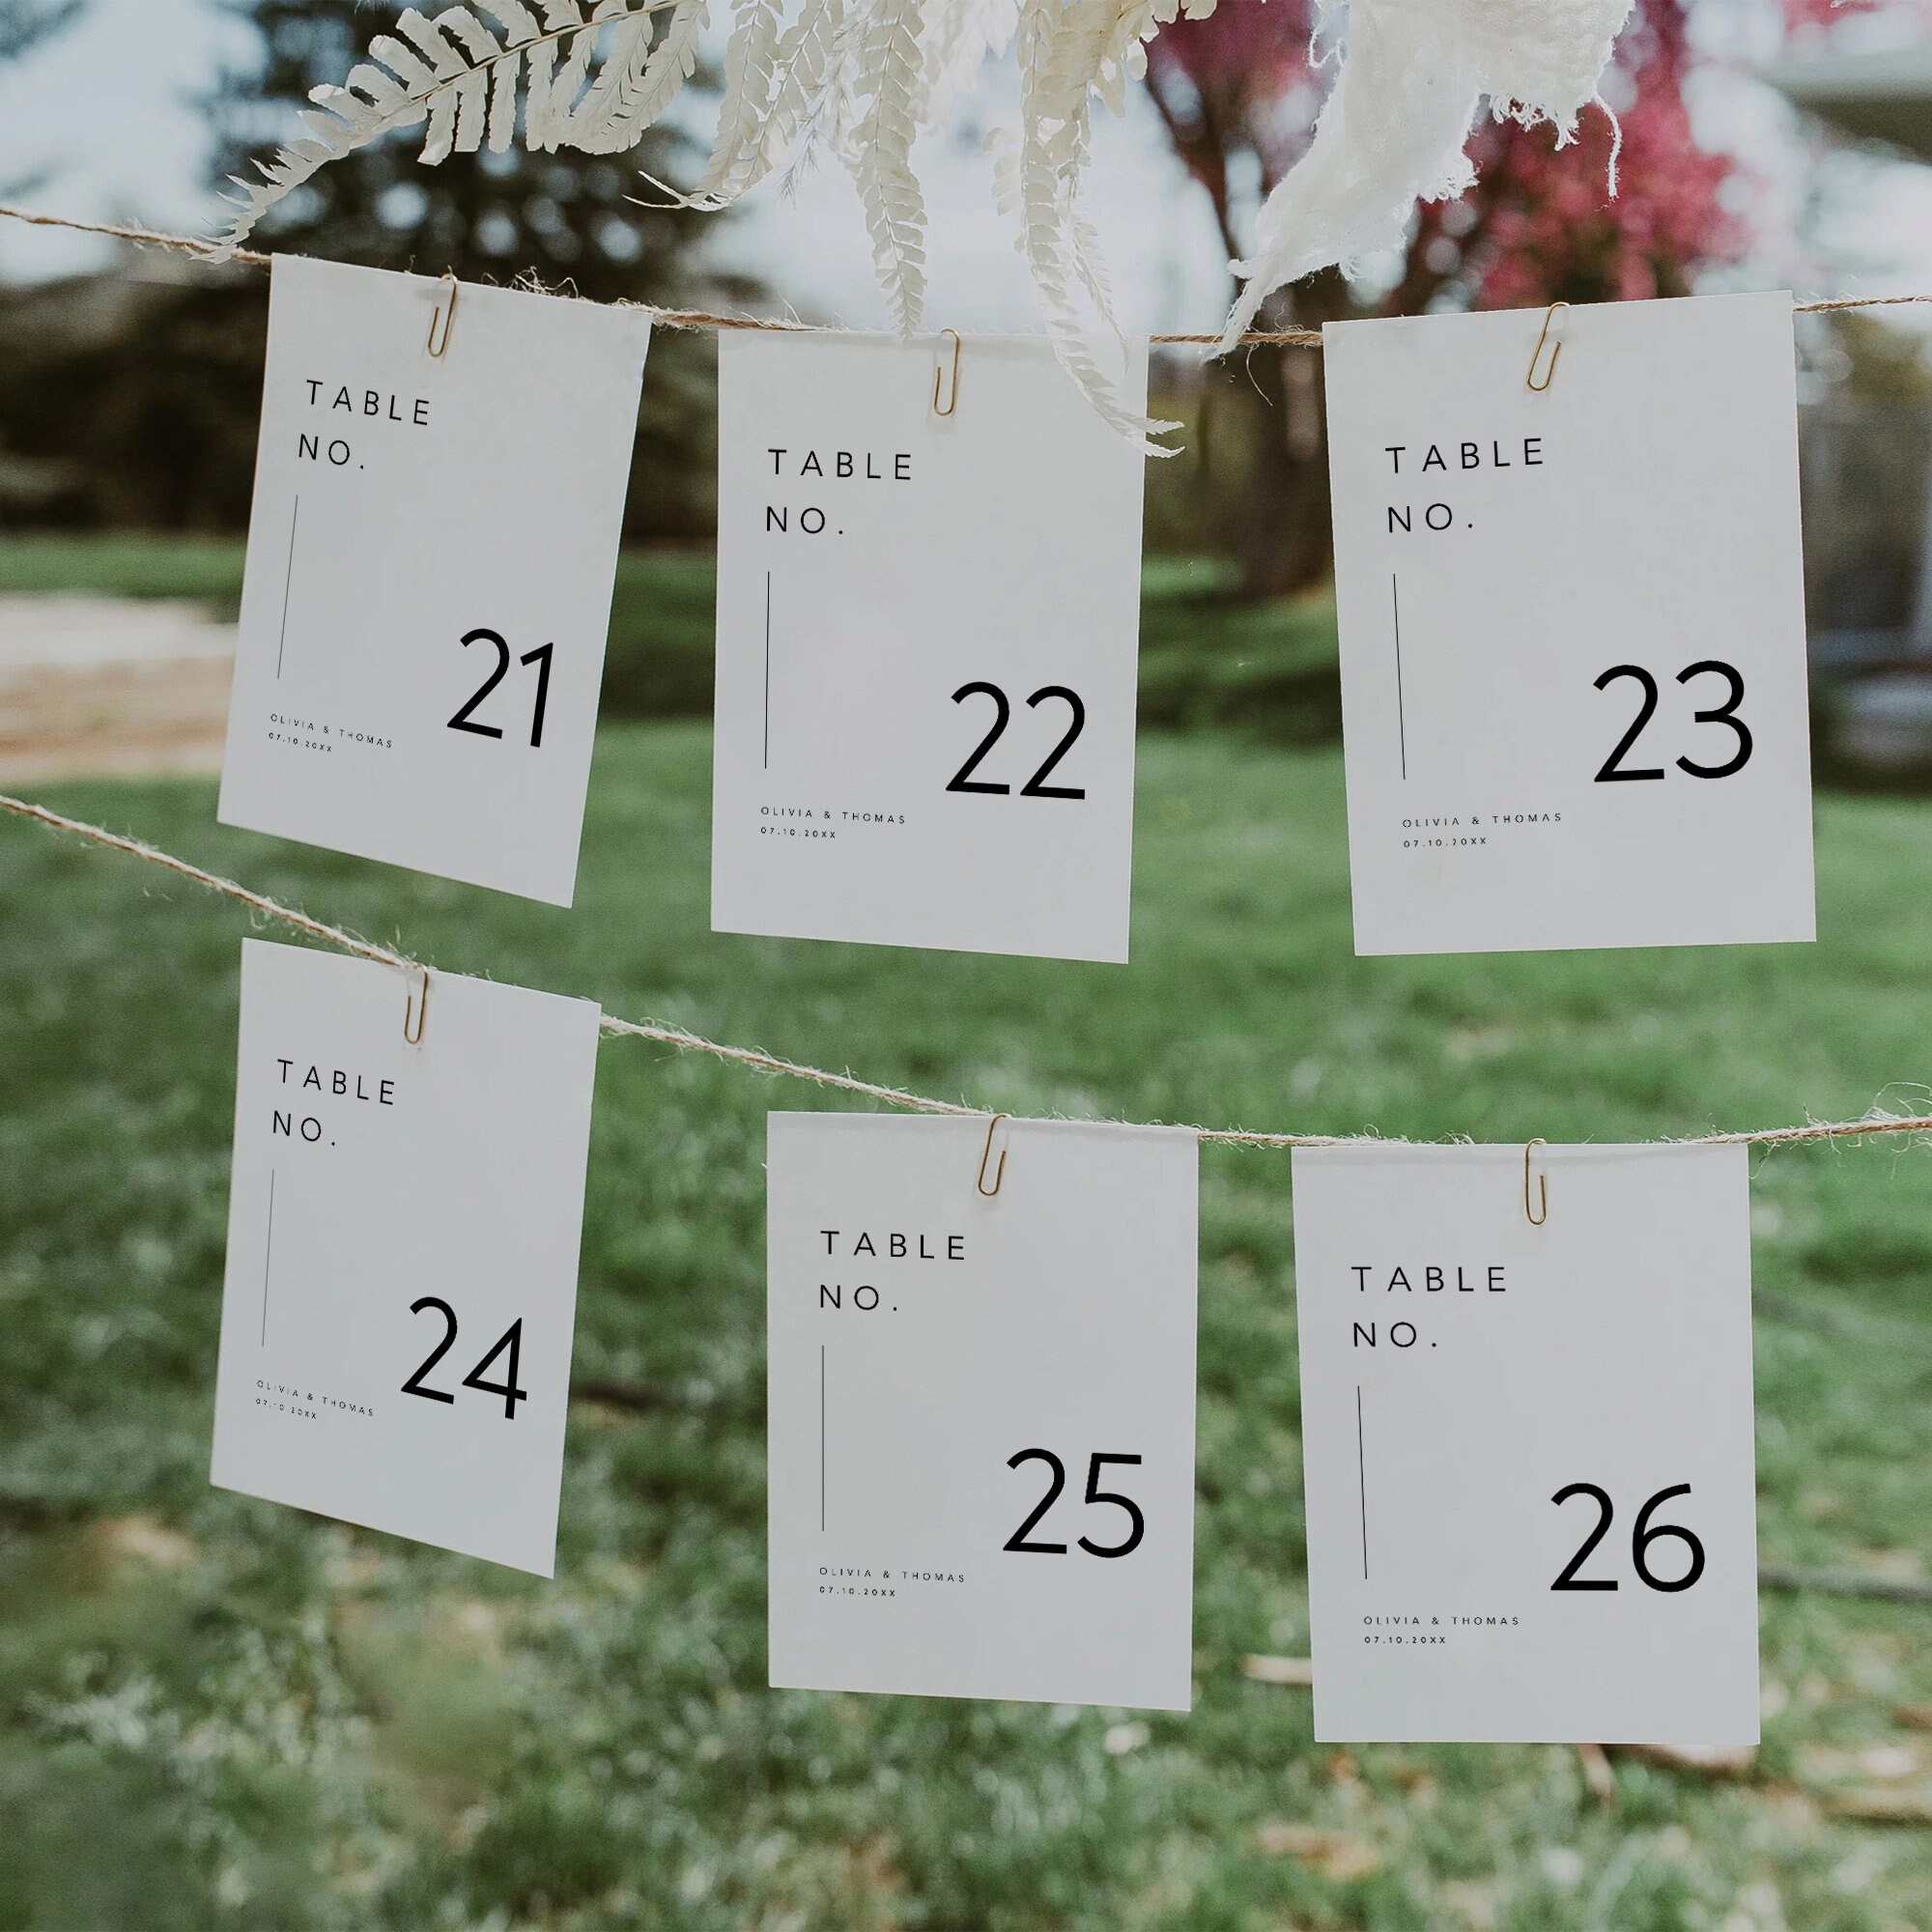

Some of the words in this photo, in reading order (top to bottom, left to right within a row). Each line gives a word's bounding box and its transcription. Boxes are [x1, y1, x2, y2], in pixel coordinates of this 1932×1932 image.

[305, 378, 430, 427] TABLE
[298, 433, 364, 470] NO.
[767, 447, 912, 481] TABLE
[1384, 437, 1544, 474] TABLE
[766, 505, 844, 535] NO.
[1387, 502, 1473, 534] NO.
[447, 628, 554, 749] 21
[270, 713, 315, 731] OLIVIA
[323, 725, 329, 735] &
[339, 728, 392, 749] THOMAS
[1593, 659, 1754, 783] 23
[946, 681, 1086, 801] 22
[760, 806, 812, 818] OLIVIA
[823, 810, 832, 820] &
[841, 810, 905, 825] THOMAS
[1402, 816, 1460, 829] OLIVIA
[1471, 815, 1480, 826] &
[1492, 812, 1562, 825] THOMAS
[760, 826, 836, 839] 07.10.20XX
[1403, 837, 1487, 849] 07.10.20XX
[276, 1058, 395, 1106] TABLE
[272, 1109, 336, 1148] NO.
[819, 1230, 965, 1261] TABLE
[1350, 1265, 1507, 1293] TABLE
[819, 1284, 897, 1312] NO.
[1352, 1321, 1437, 1349] NO.
[401, 1295, 528, 1421] 24
[256, 1379, 298, 1398] OLIVIA
[306, 1392, 314, 1402] &
[322, 1396, 374, 1417] THOMAS
[1003, 1447, 1145, 1559] 25
[1549, 1482, 1706, 1594] 26
[819, 1567, 871, 1577] OLIVIA
[882, 1570, 891, 1579] &
[901, 1571, 964, 1583] THOMAS
[819, 1585, 895, 1598] 07.10.20XX
[1362, 1615, 1420, 1626] OLIVIA
[1431, 1616, 1439, 1626] &
[1451, 1616, 1520, 1626] THOMAS
[1363, 1635, 1446, 1644] 07.10.20XX
